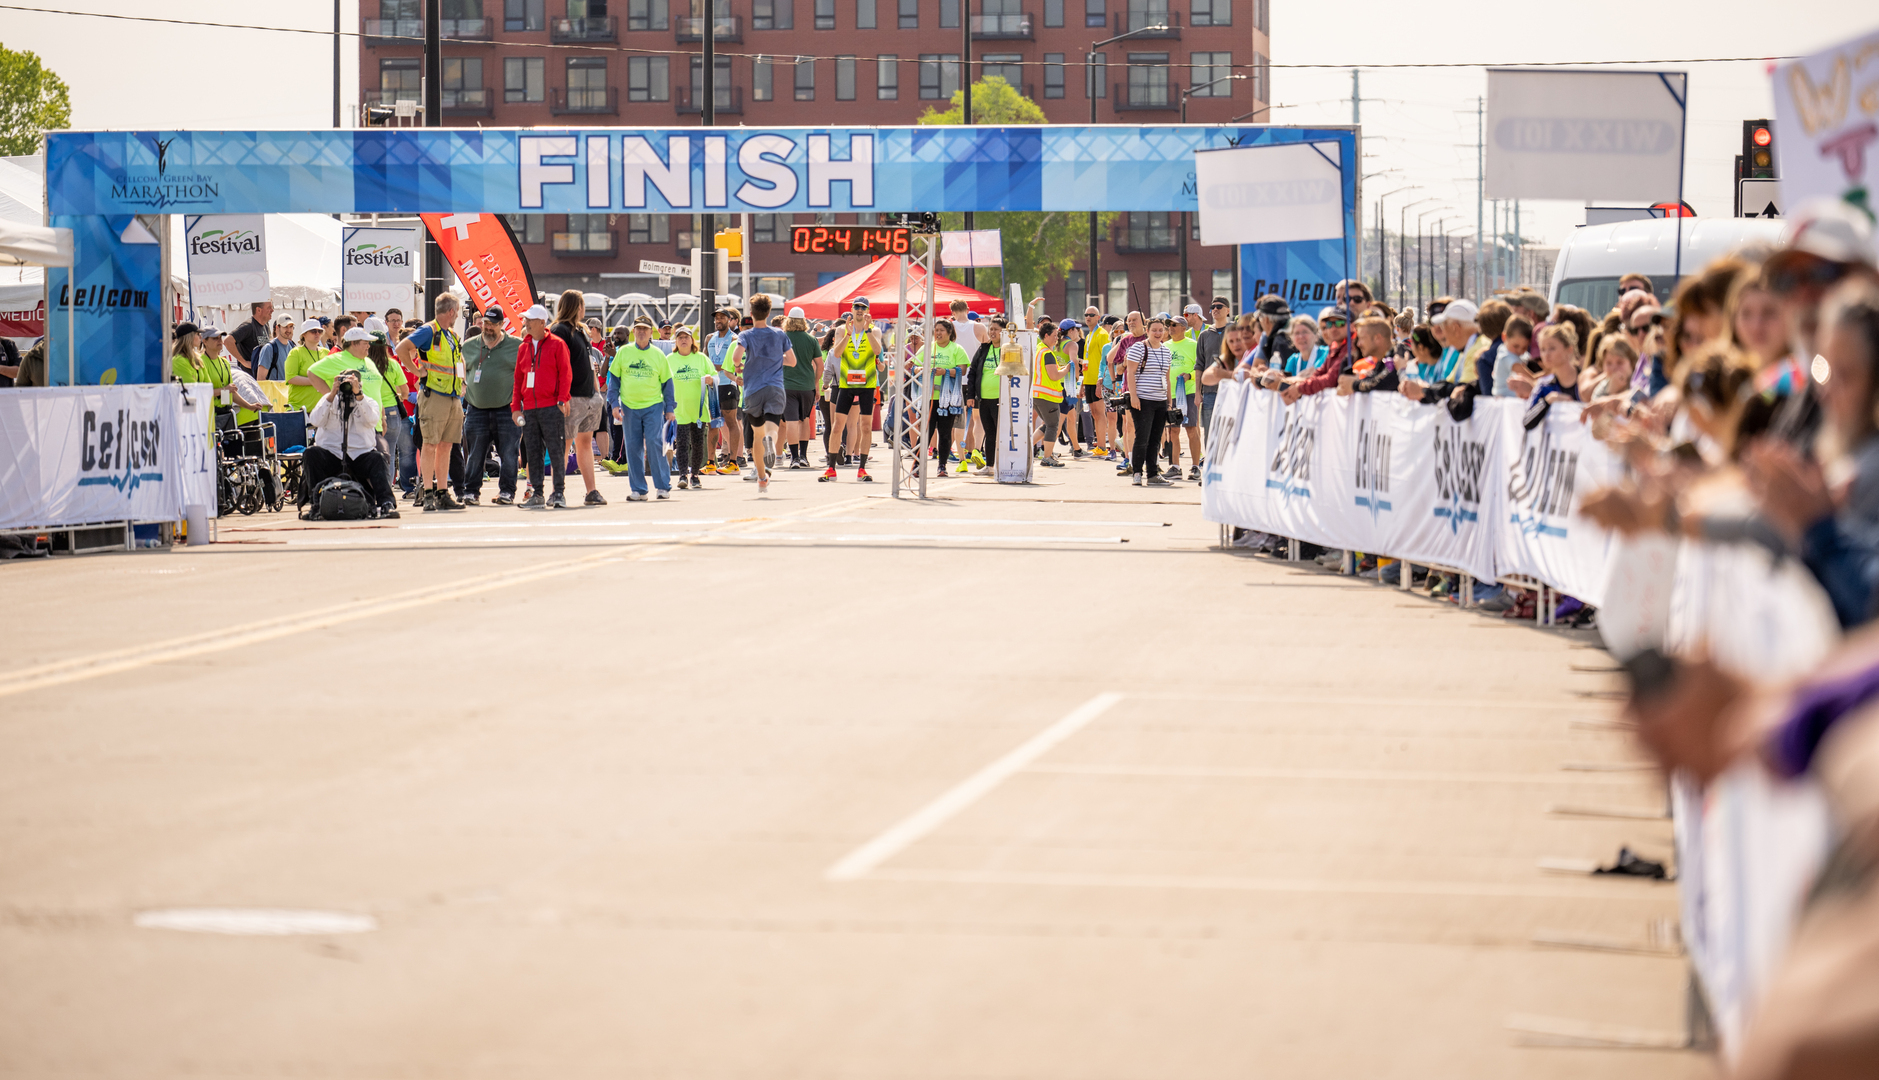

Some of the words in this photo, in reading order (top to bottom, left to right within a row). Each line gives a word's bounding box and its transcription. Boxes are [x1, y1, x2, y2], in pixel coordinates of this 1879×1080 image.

[116, 174, 158, 183] CELLCOM
[163, 173, 194, 183] GREEN
[196, 173, 213, 183] BAY
[518, 133, 875, 210] FINISH
[111, 182, 219, 199] MARATHON
[190, 234, 261, 256] festival
[346, 247, 410, 267] festival
[643, 262, 677, 276] Holmgren
[59, 283, 149, 309] Cellcom
[1009, 396, 1020, 451] BELL
[81, 408, 160, 472] Cellcom
